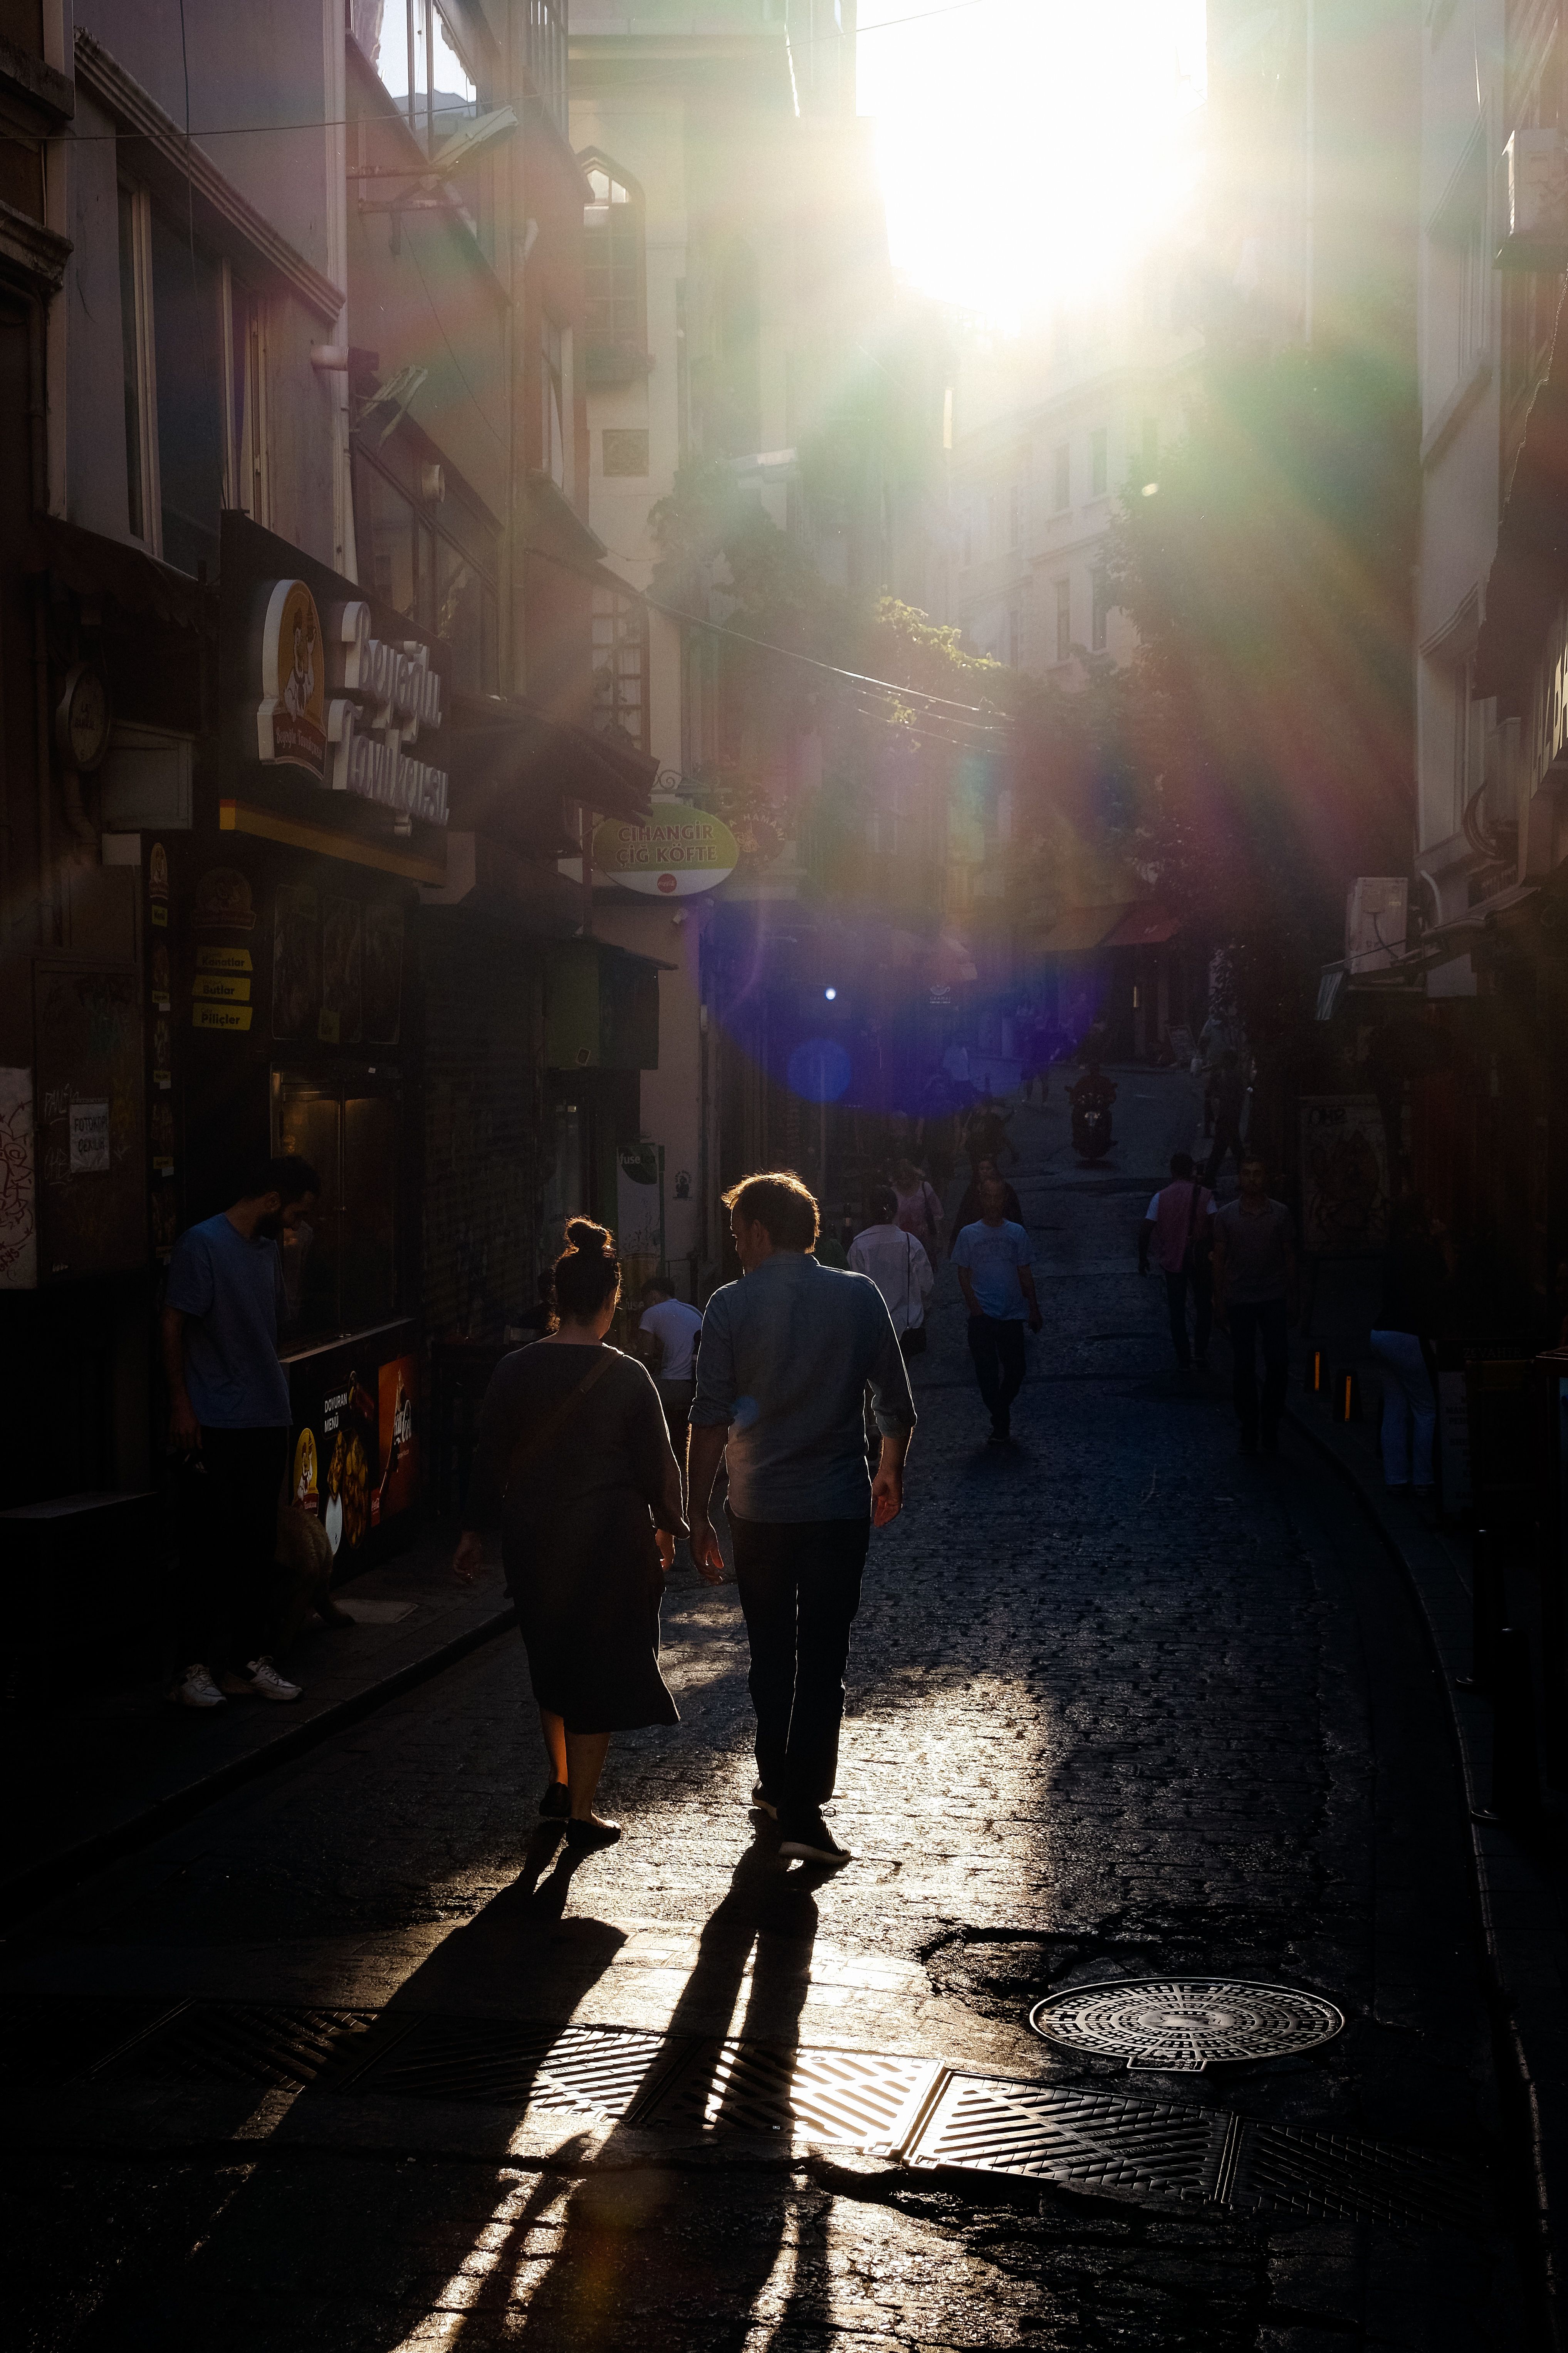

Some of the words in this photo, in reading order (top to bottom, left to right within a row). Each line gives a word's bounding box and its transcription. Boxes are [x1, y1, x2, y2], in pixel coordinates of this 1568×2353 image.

[341, 601, 442, 744] Beyoğlu
[327, 699, 450, 837] Tavukçusu
[616, 845, 649, 867] ÇİĞ
[656, 843, 717, 863] KÖFTE
[202, 956, 245, 966] Kanatlar
[203, 985, 235, 994] Butlar
[201, 1013, 240, 1026] Piliçler
[324, 1392, 348, 1413] DOYURAN
[324, 1411, 339, 1433] MENÜ
